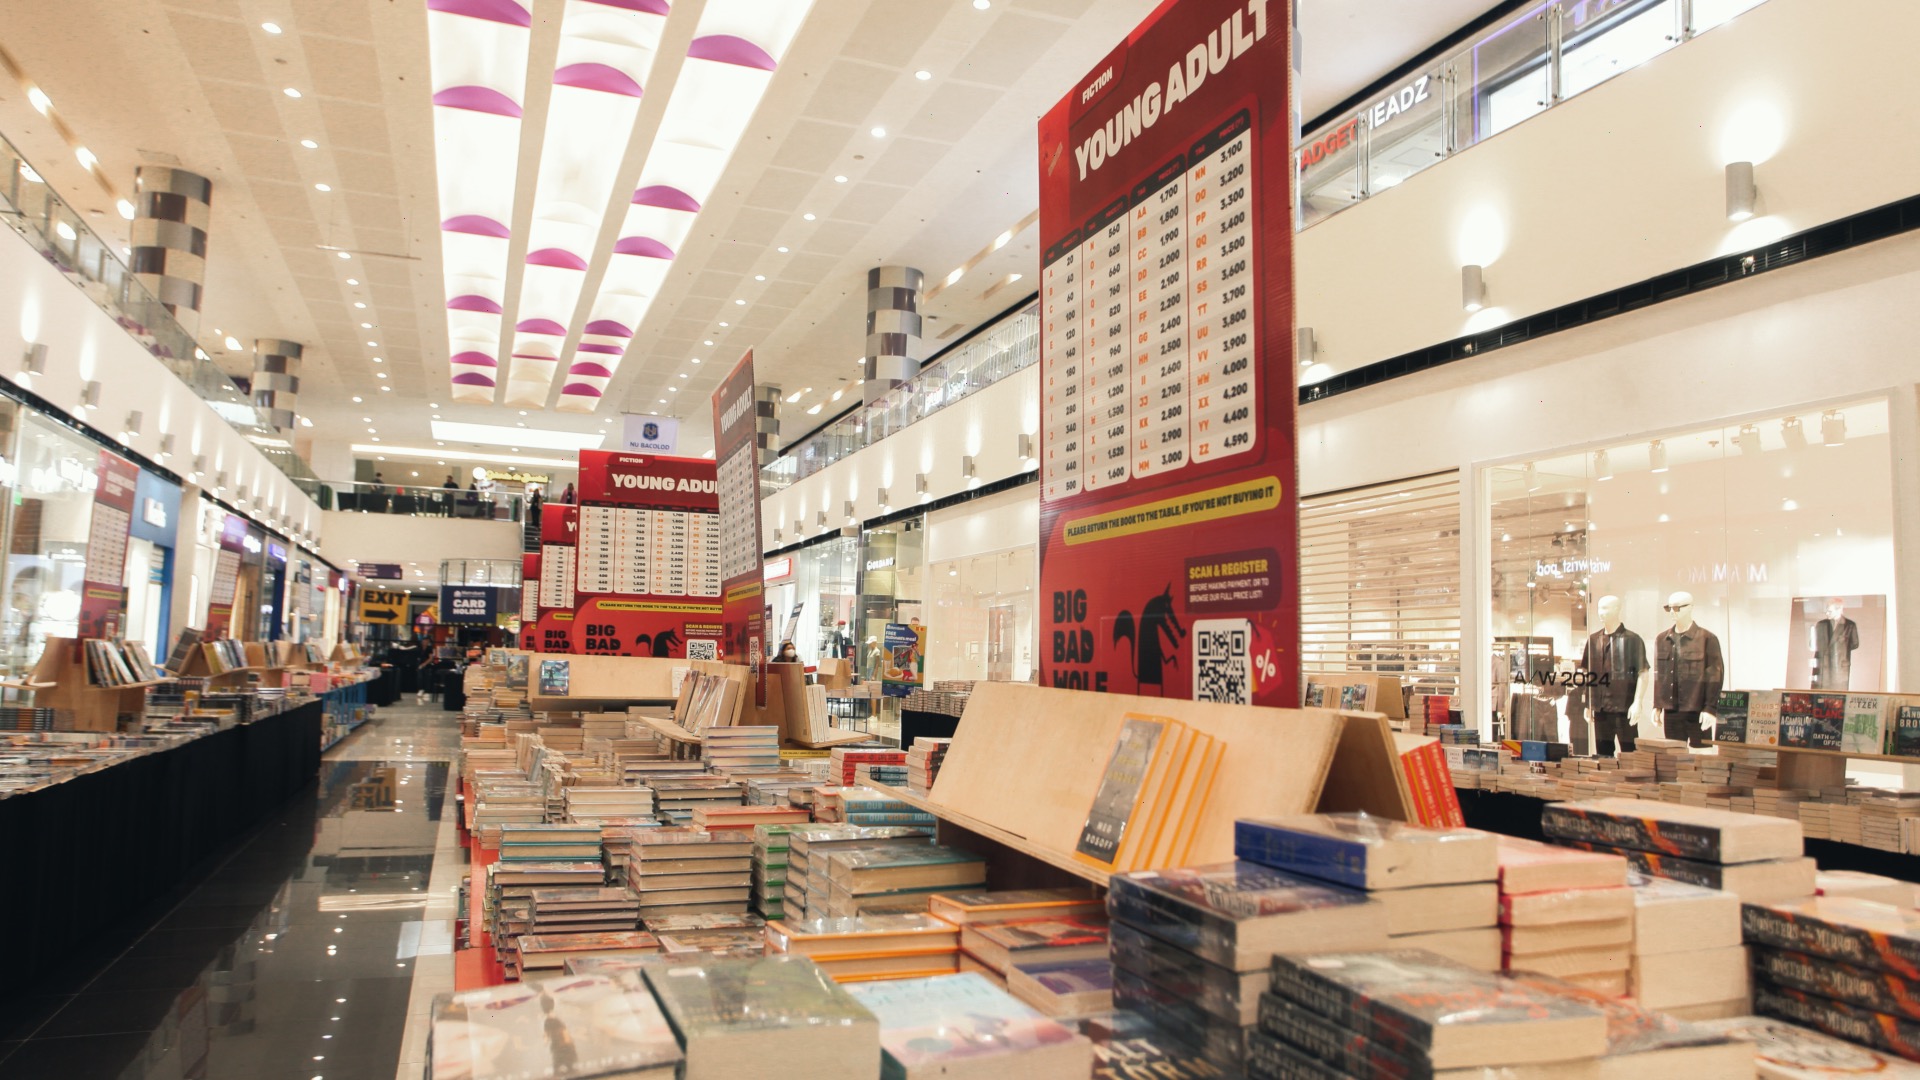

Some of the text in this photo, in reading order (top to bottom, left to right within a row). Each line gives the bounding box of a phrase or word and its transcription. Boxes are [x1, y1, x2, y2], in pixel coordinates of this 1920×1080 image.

[1075, 0, 1268, 181] YOUNG ADULT
[1082, 66, 1112, 104] FICTION
[1220, 141, 1243, 163] 3,100
[1301, 118, 1358, 170] ADGET
[1219, 164, 1244, 186] 3,200
[1136, 208, 1148, 220] AA
[1159, 184, 1179, 203] 1,700
[1195, 188, 1245, 224] PP 3,300
[1108, 223, 1121, 238] 560
[1137, 206, 1179, 240] BB 1,800
[1220, 212, 1245, 233] 3,400
[1108, 243, 1121, 257] 620
[1136, 228, 1179, 261] CC 1,900
[1066, 255, 1074, 266] 20
[1195, 236, 1246, 271] RR 3,500
[1108, 263, 1121, 277] 660
[1136, 249, 1180, 281] DD 2,000
[1195, 260, 1246, 293] SS 3,600
[1137, 272, 1180, 302] EE 2,100
[1066, 292, 1074, 302] 60
[1196, 285, 1246, 315] TT 3,700
[1137, 293, 1181, 321] FF 2,200
[1065, 310, 1076, 321] 100
[1137, 316, 1182, 343] GG 2,400
[1196, 309, 1247, 339] UU 3,800
[1065, 329, 1076, 340] 120
[1109, 344, 1122, 357] 960
[1160, 338, 1182, 355] 2,500
[1197, 333, 1247, 362] VV 3,900
[1065, 366, 1076, 377] 180
[1108, 364, 1124, 377] 1,100
[1160, 360, 1182, 377] 2,600
[1222, 358, 1248, 375] 4,000
[1065, 385, 1077, 397] 220
[1107, 384, 1125, 398] 1,200
[1138, 383, 1182, 407] JJ 2,700
[1222, 383, 1248, 399] 4,200
[720, 384, 752, 435] YOUNG ADULT
[1065, 404, 1077, 415] 280
[1107, 404, 1125, 418] 1,300
[1138, 405, 1182, 428] KK 2,800
[1223, 407, 1249, 423] 4,400
[1065, 423, 1077, 434] 340
[1107, 425, 1125, 438] 1,400
[640, 442, 670, 450] BACOLOD
[1139, 428, 1182, 450] LL 2,900
[1198, 432, 1249, 456] ZZ 4,590
[1107, 446, 1125, 459] 1,520
[1161, 451, 1183, 465] 3,000
[1065, 461, 1077, 471] 440
[1107, 467, 1125, 479] 1,600
[612, 473, 675, 491] YOUNG
[1065, 480, 1077, 491] 500
[1068, 526, 1086, 537] PLEASE
[1087, 521, 1108, 533] RETURN
[1109, 519, 1120, 529] THE
[1120, 515, 1136, 527] BOOK
[1137, 513, 1145, 523] TO
[1146, 510, 1158, 521] THE
[1182, 504, 1189, 514] IF
[1189, 498, 1215, 512] YOU'RE
[1216, 494, 1232, 507] NOT
[1233, 488, 1264, 504] BUYING
[1265, 485, 1274, 497] IT
[1189, 559, 1268, 579] SCAN & REGISTER
[364, 590, 406, 606] EXIT
[453, 599, 486, 608] CARD
[1053, 588, 1087, 623] BIG
[545, 630, 567, 638] BIG
[586, 624, 615, 636] BIG
[544, 640, 570, 648] BAD
[585, 638, 621, 650] BAD
[1053, 629, 1094, 663] BAD
[1514, 669, 1610, 687] A/W 2024
[1720, 699, 1745, 707] KERR
[1750, 710, 1777, 718] PENNY
[1900, 719, 1920, 728] BRO
[1823, 739, 1841, 747] OFFIC
[866, 801, 883, 810] OUR
[868, 813, 885, 822] OUR
[914, 812, 936, 821] IDEAS
[1096, 821, 1112, 834] MEG
[1085, 833, 1113, 850] ROSOFF
[1815, 926, 1863, 960] MIRROR
